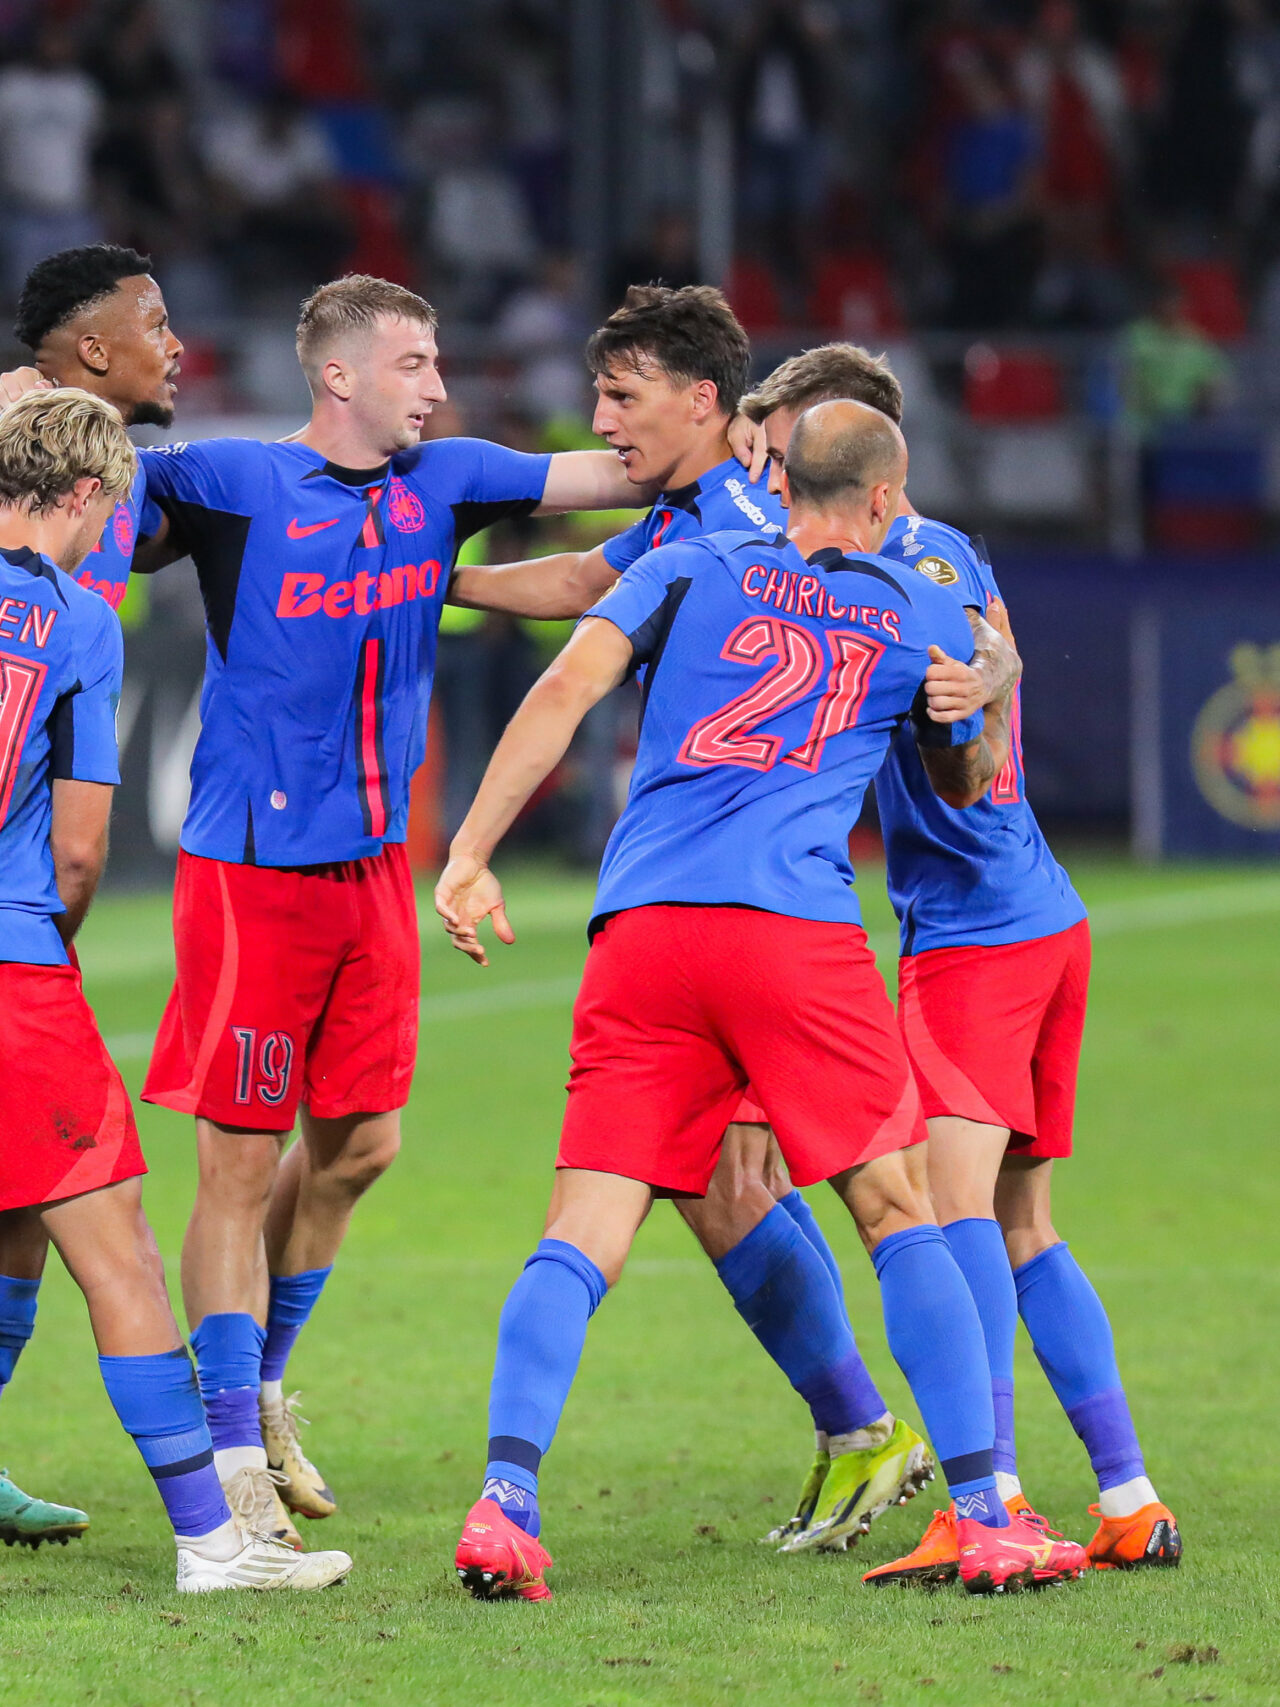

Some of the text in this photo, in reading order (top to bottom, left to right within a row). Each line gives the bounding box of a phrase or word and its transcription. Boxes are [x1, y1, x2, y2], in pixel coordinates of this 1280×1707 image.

[276, 559, 441, 618] Betano
[676, 615, 887, 773] 21
[230, 1025, 295, 1108] 19
